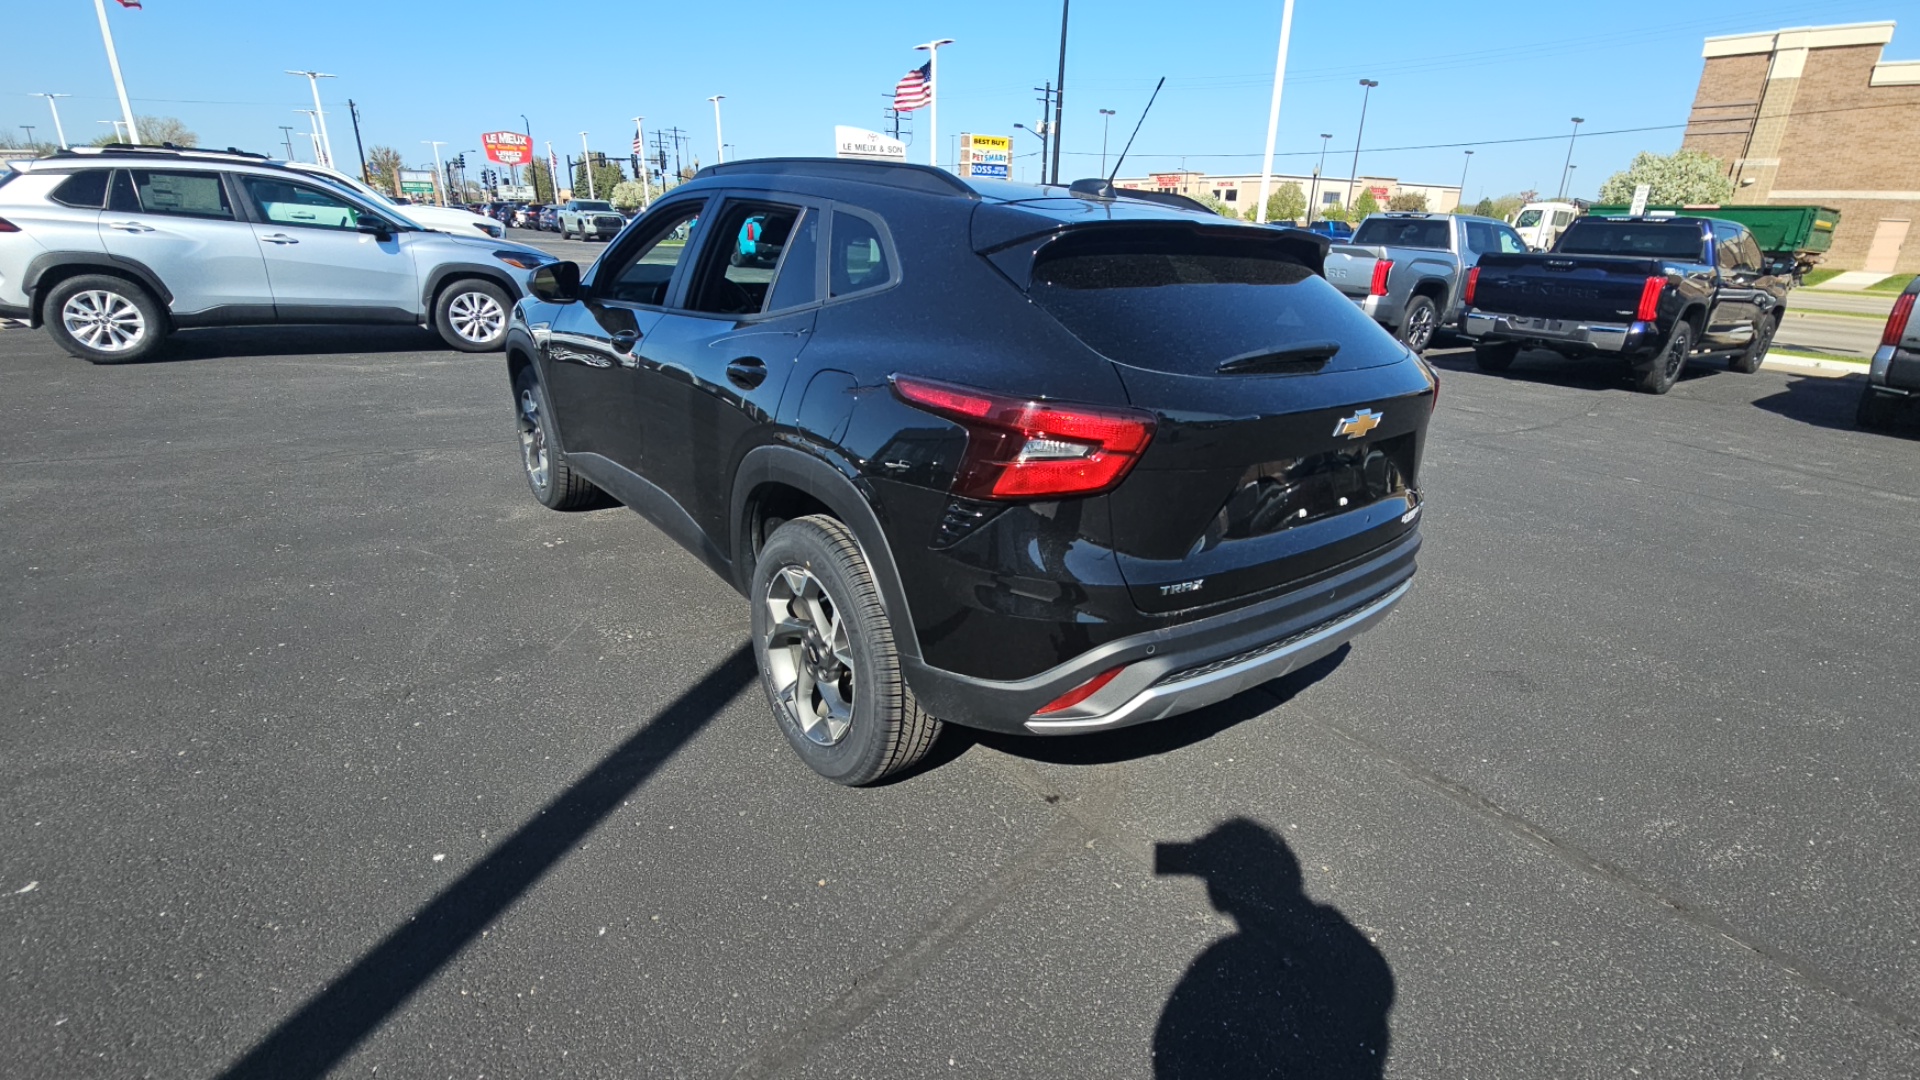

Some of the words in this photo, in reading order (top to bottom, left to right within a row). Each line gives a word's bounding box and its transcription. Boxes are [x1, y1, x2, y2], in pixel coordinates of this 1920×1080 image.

[485, 134, 497, 144] LE
[498, 132, 527, 145] MIEUX
[842, 143, 852, 151] LE
[854, 144, 876, 152] MIEUX
[972, 165, 992, 174] ROSS
[1160, 579, 1204, 596] TRAX
